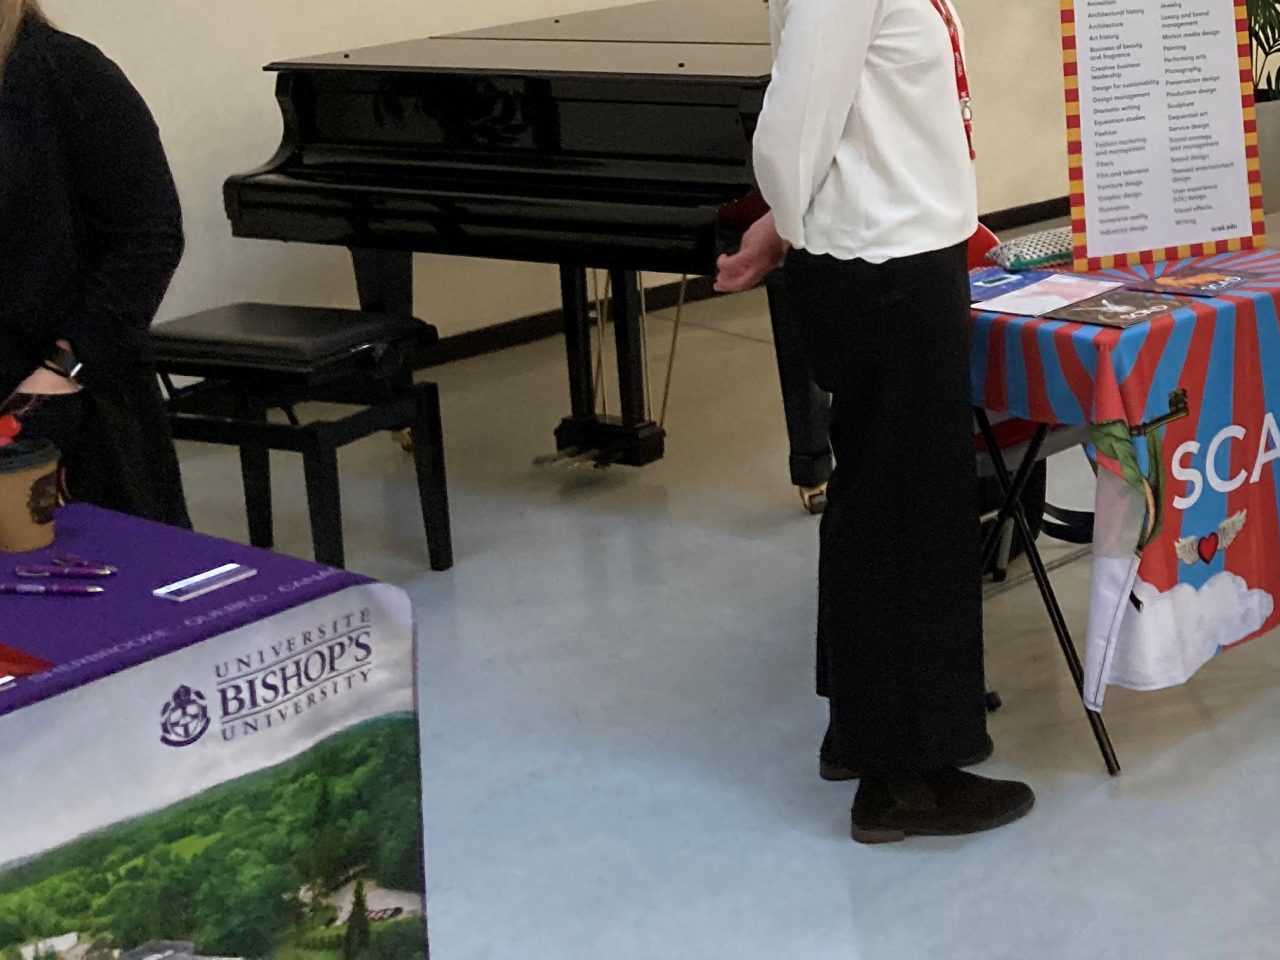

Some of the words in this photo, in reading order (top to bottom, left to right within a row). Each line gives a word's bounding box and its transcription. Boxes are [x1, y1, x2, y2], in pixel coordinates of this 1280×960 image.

[1090, 65, 1116, 73] Creative
[217, 630, 373, 719] BISHOP'S
[221, 668, 372, 742] UNIVERSITY
